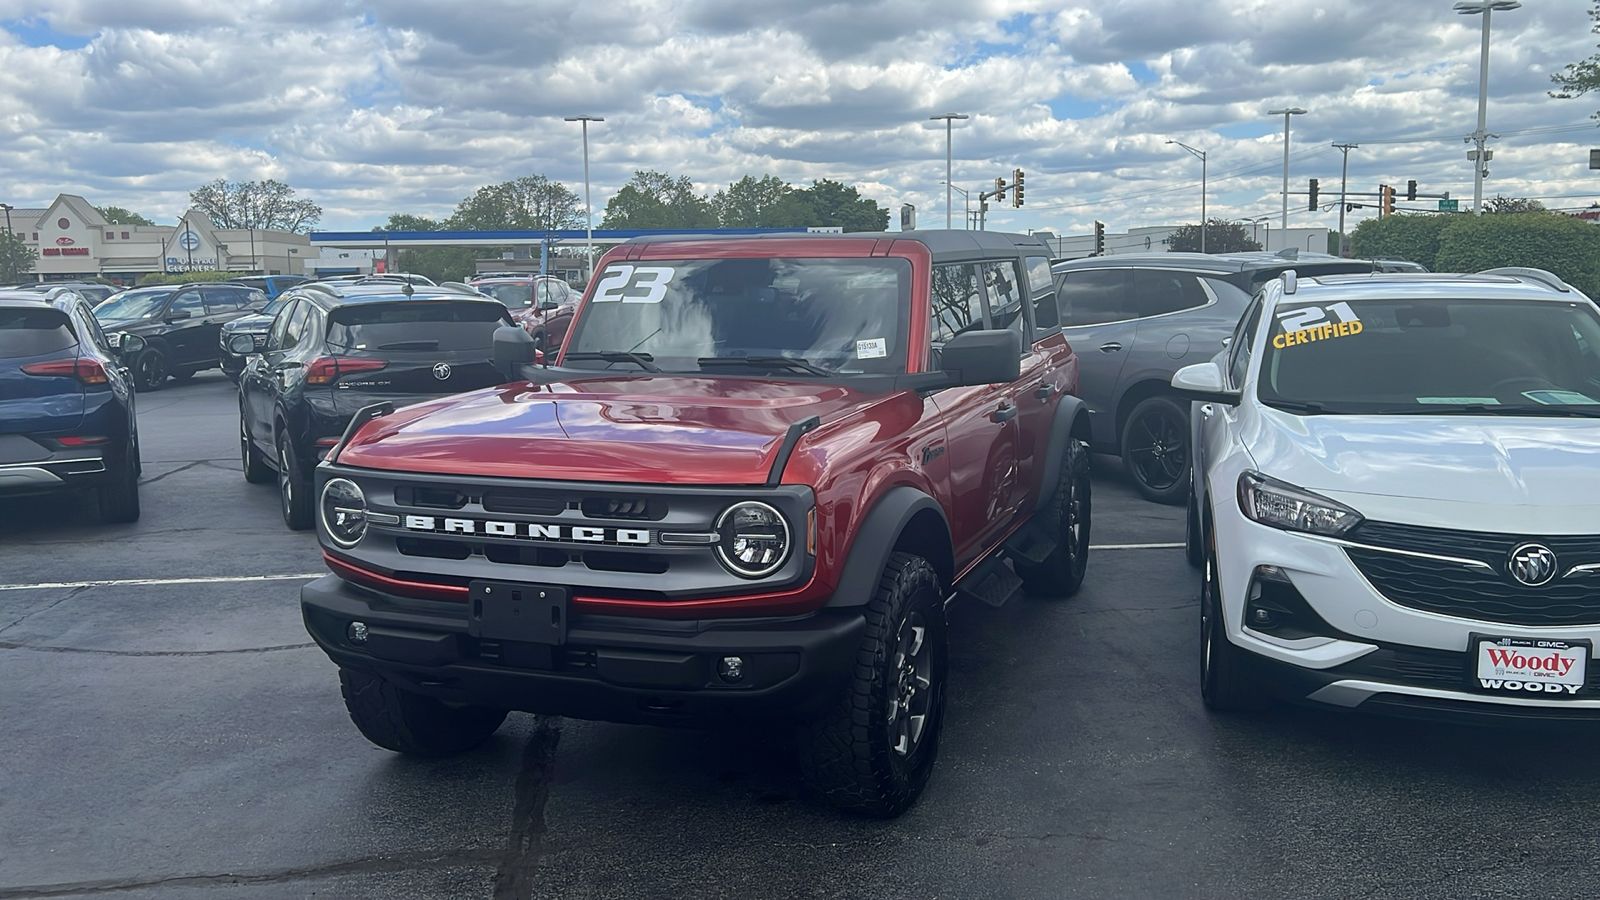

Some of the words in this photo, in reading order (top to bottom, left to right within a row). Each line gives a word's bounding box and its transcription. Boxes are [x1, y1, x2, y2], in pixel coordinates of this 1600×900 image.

[592, 265, 675, 304] 23
[1276, 301, 1361, 333] 21
[1272, 321, 1363, 349] CERTIFIED
[406, 515, 650, 544] BRONCO
[1487, 648, 1576, 677] Woody
[1480, 679, 1582, 694] WOODY
